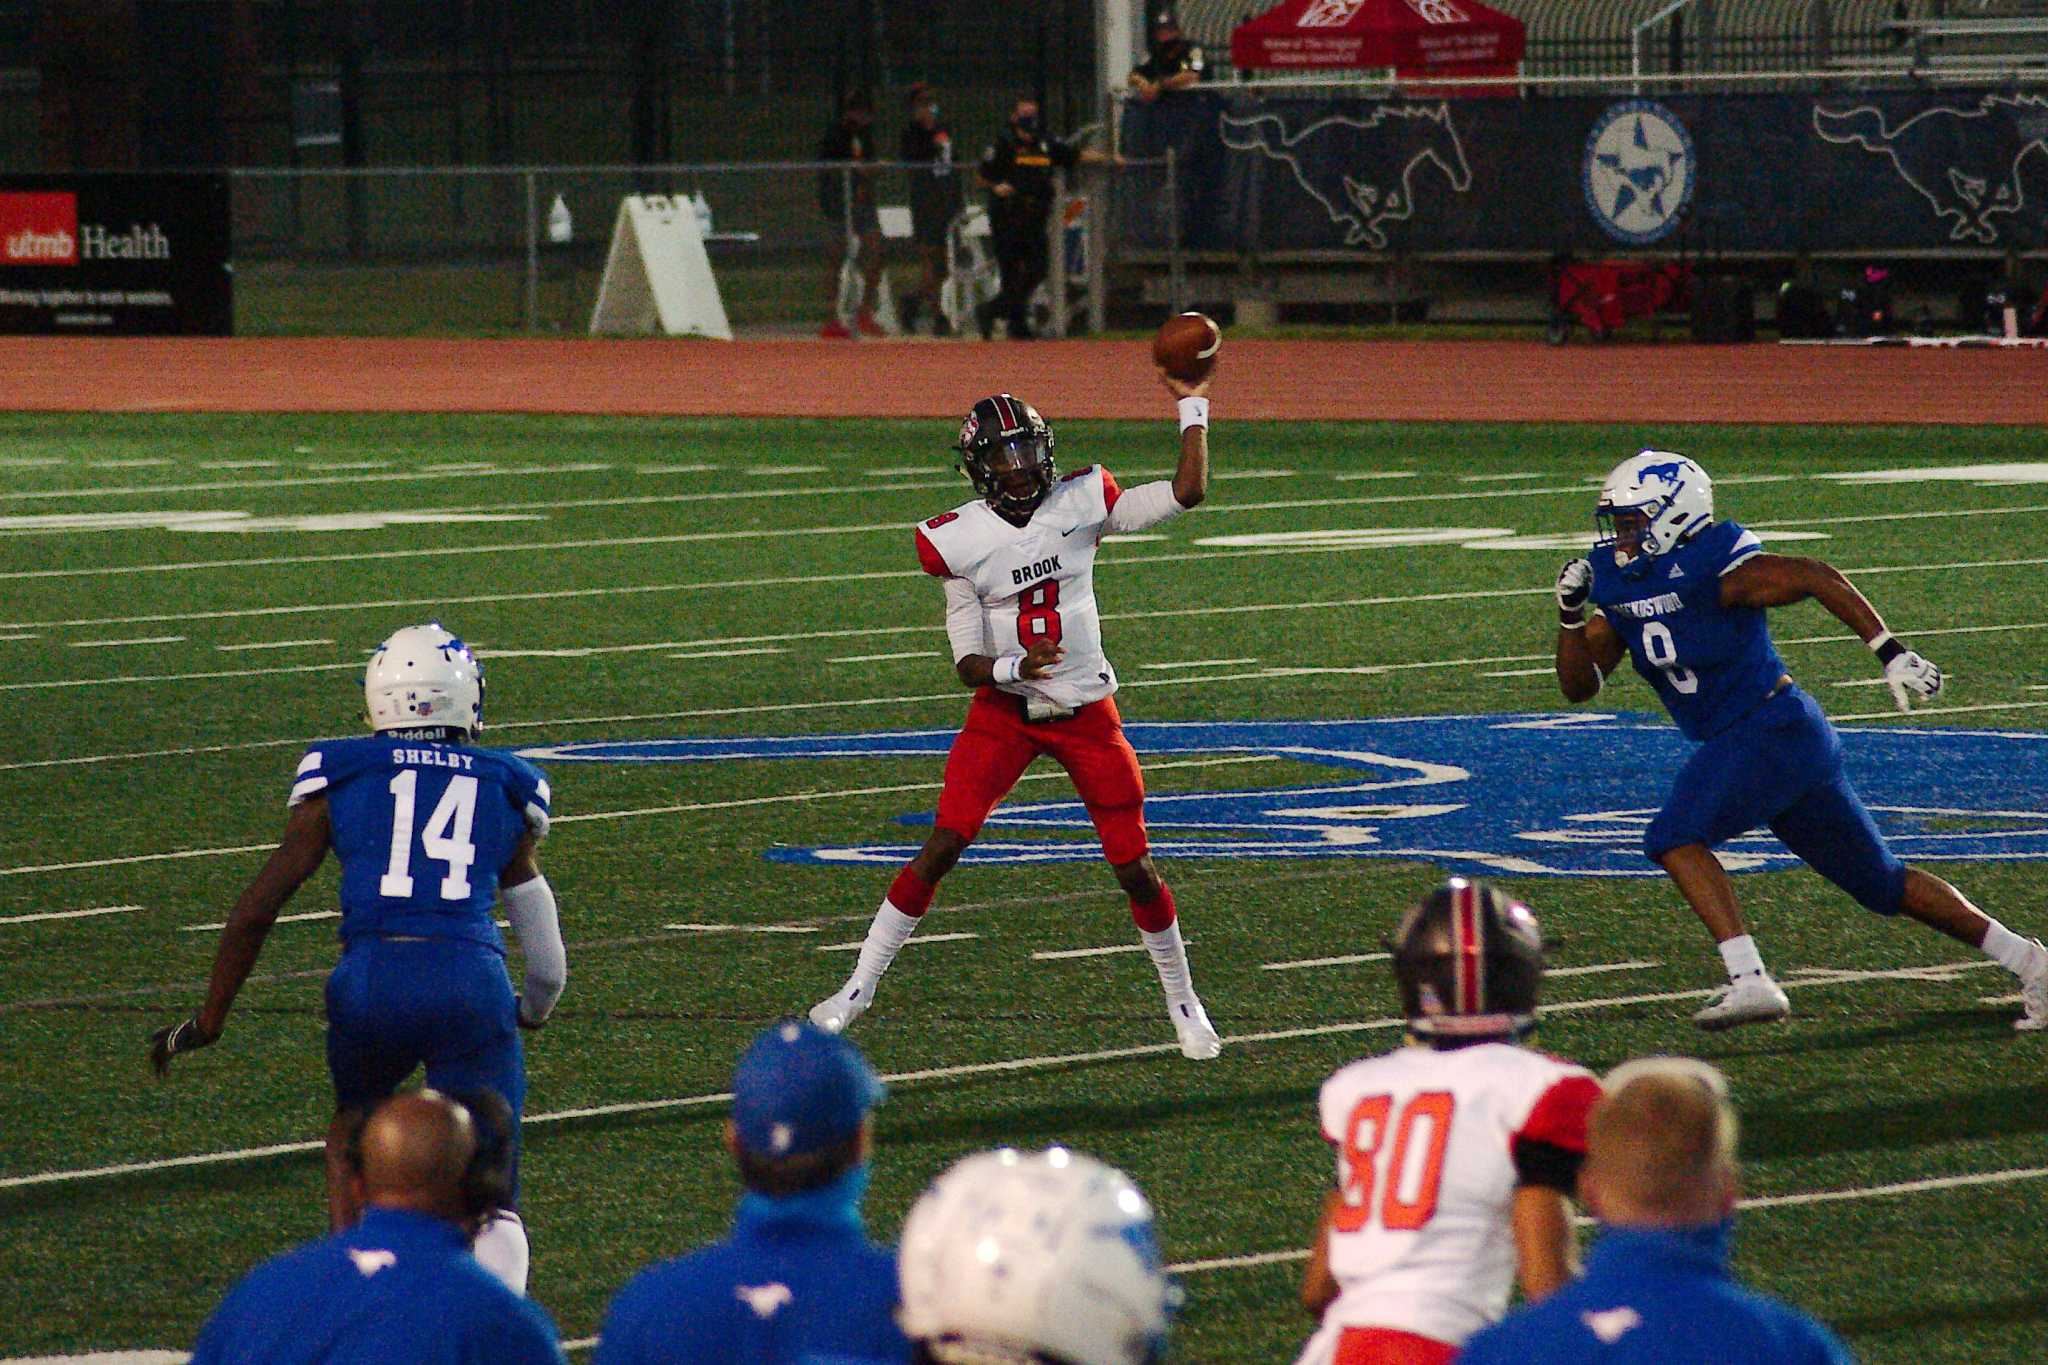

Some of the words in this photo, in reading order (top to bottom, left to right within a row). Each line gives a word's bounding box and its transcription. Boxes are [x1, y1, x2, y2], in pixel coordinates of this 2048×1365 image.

[80, 223, 170, 258] Health
[1012, 555, 1062, 585] BROOK
[1016, 577, 1063, 656] 8
[392, 748, 474, 770] SHELBY
[380, 769, 478, 900] 14
